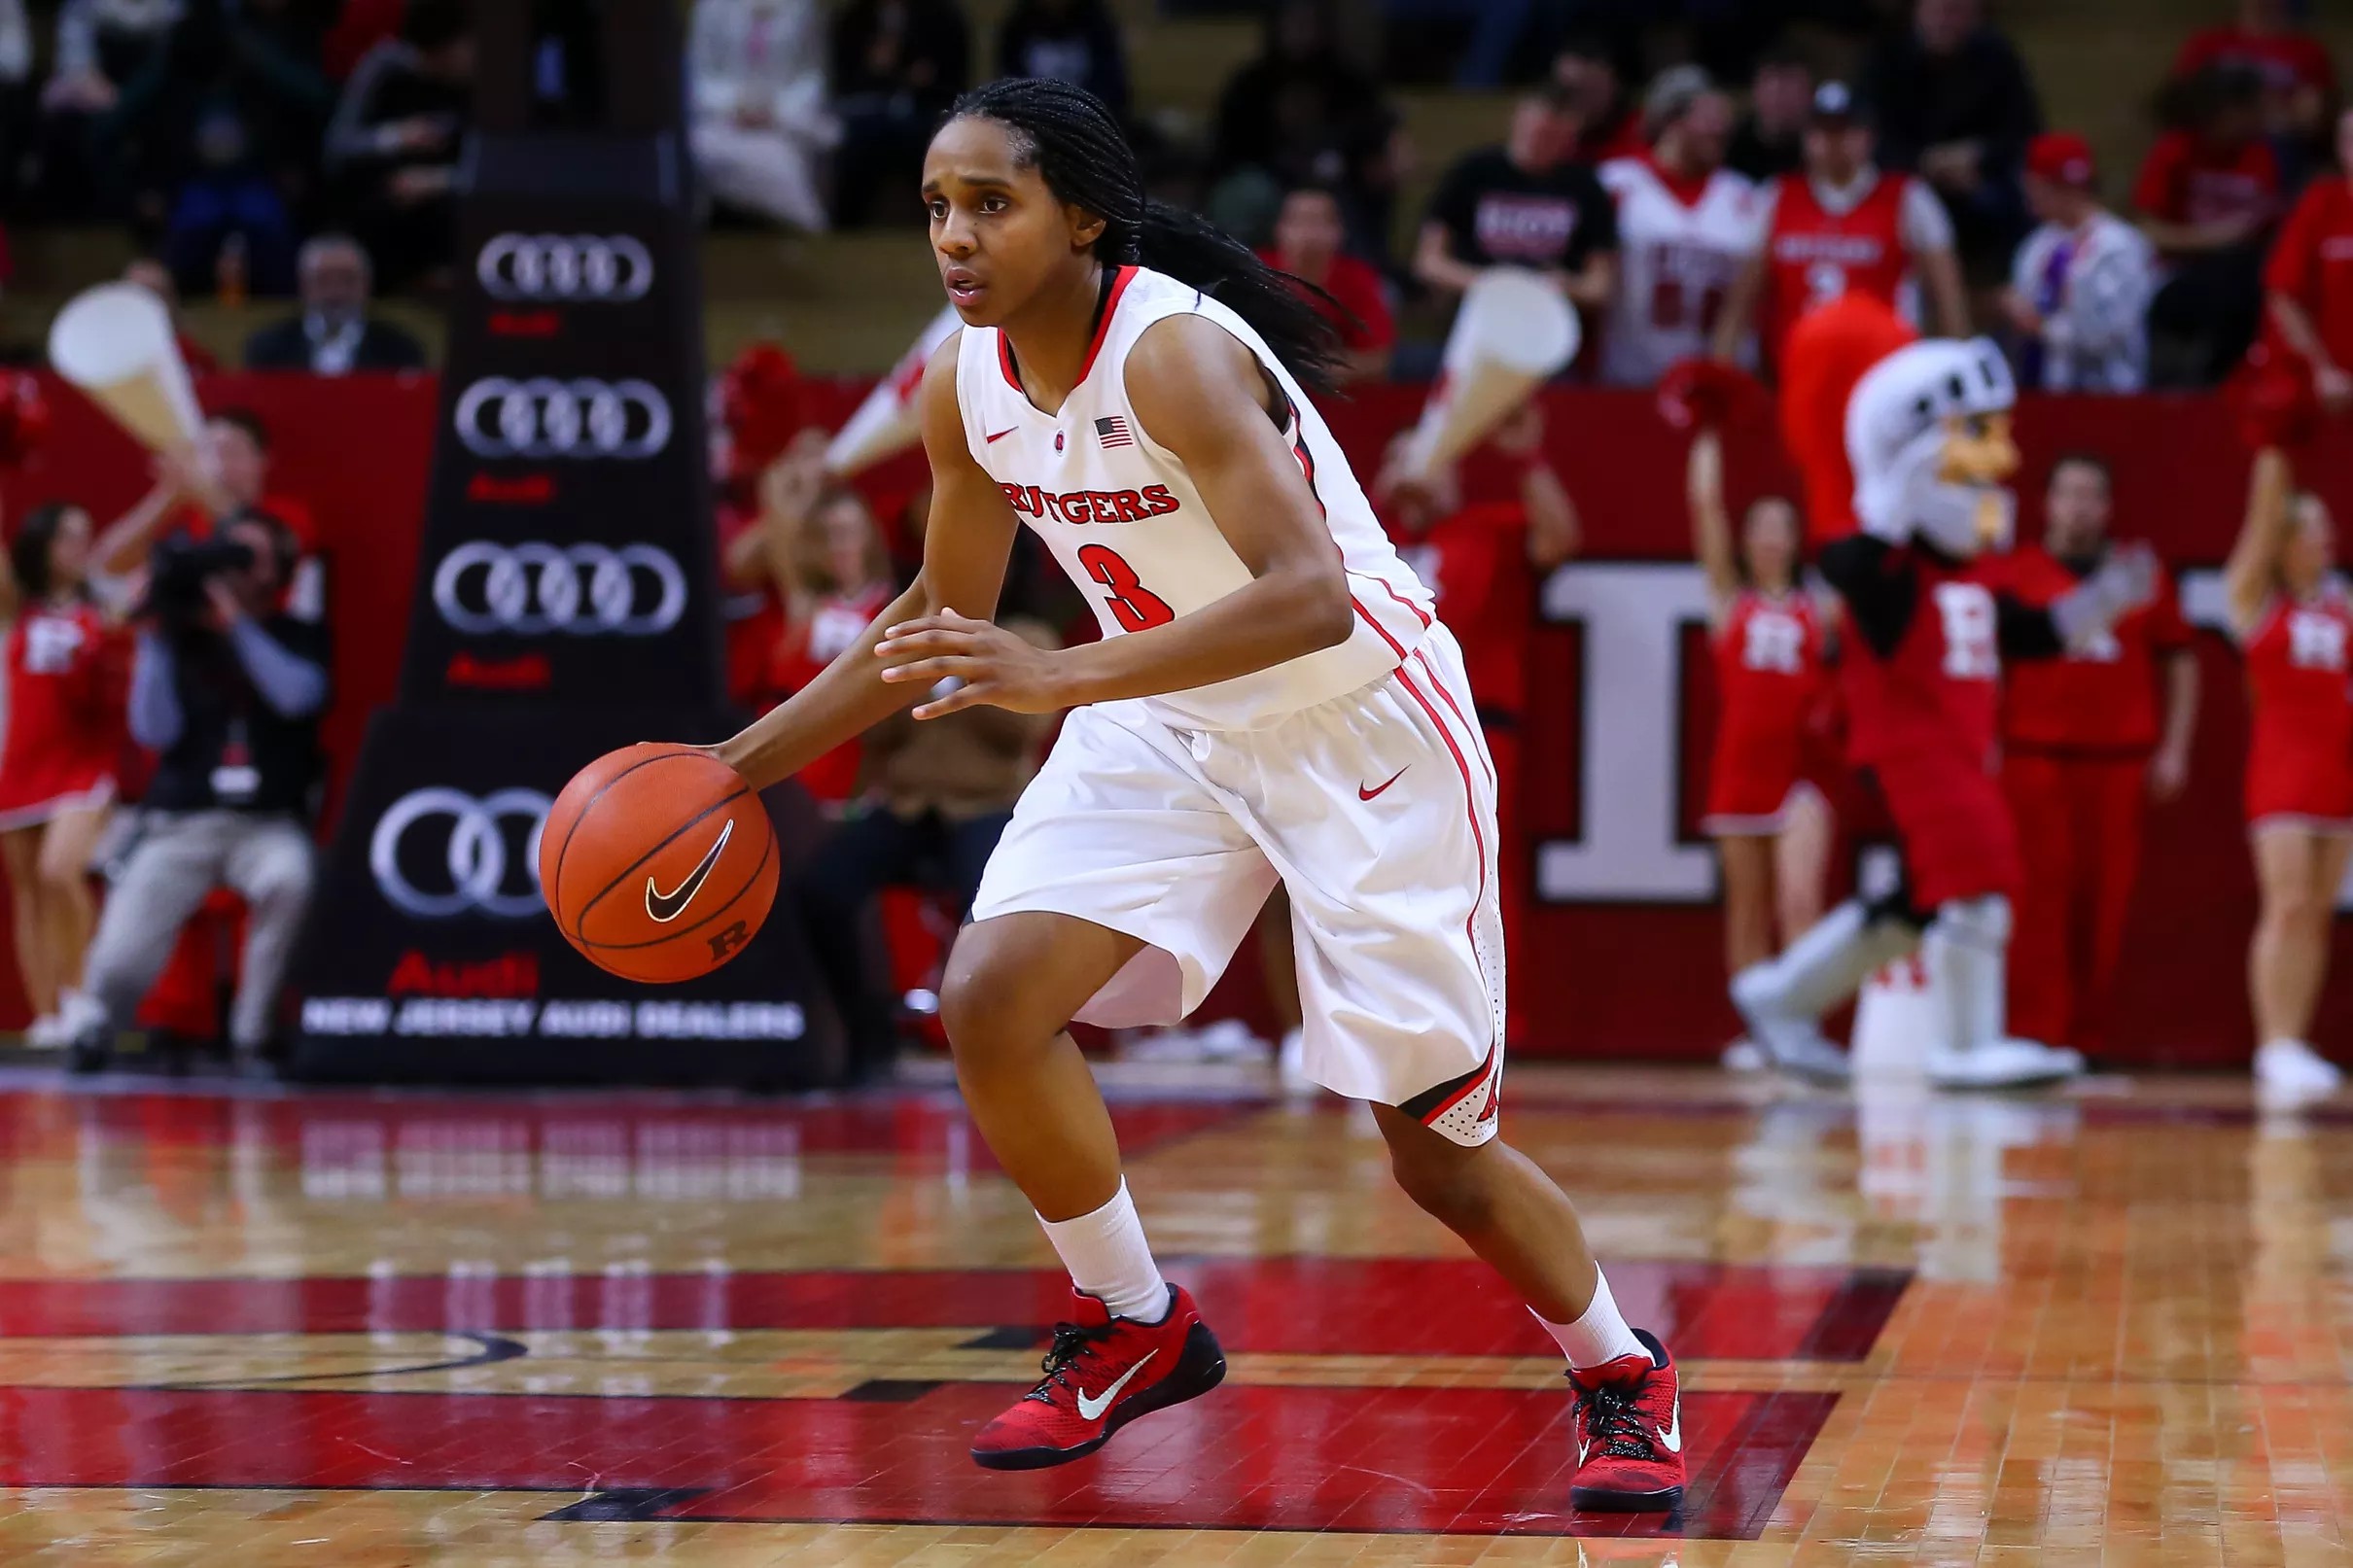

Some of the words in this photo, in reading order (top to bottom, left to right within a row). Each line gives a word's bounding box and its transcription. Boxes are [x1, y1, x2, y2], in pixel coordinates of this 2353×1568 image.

[996, 481, 1180, 525] RUTGERS
[1077, 543, 1176, 633] 3
[707, 920, 751, 963] R
[388, 948, 539, 997] Audi
[300, 996, 390, 1035] NEW
[393, 997, 537, 1036] JERSEY
[539, 999, 632, 1038] AUDI
[635, 1000, 806, 1040] DEALERS
